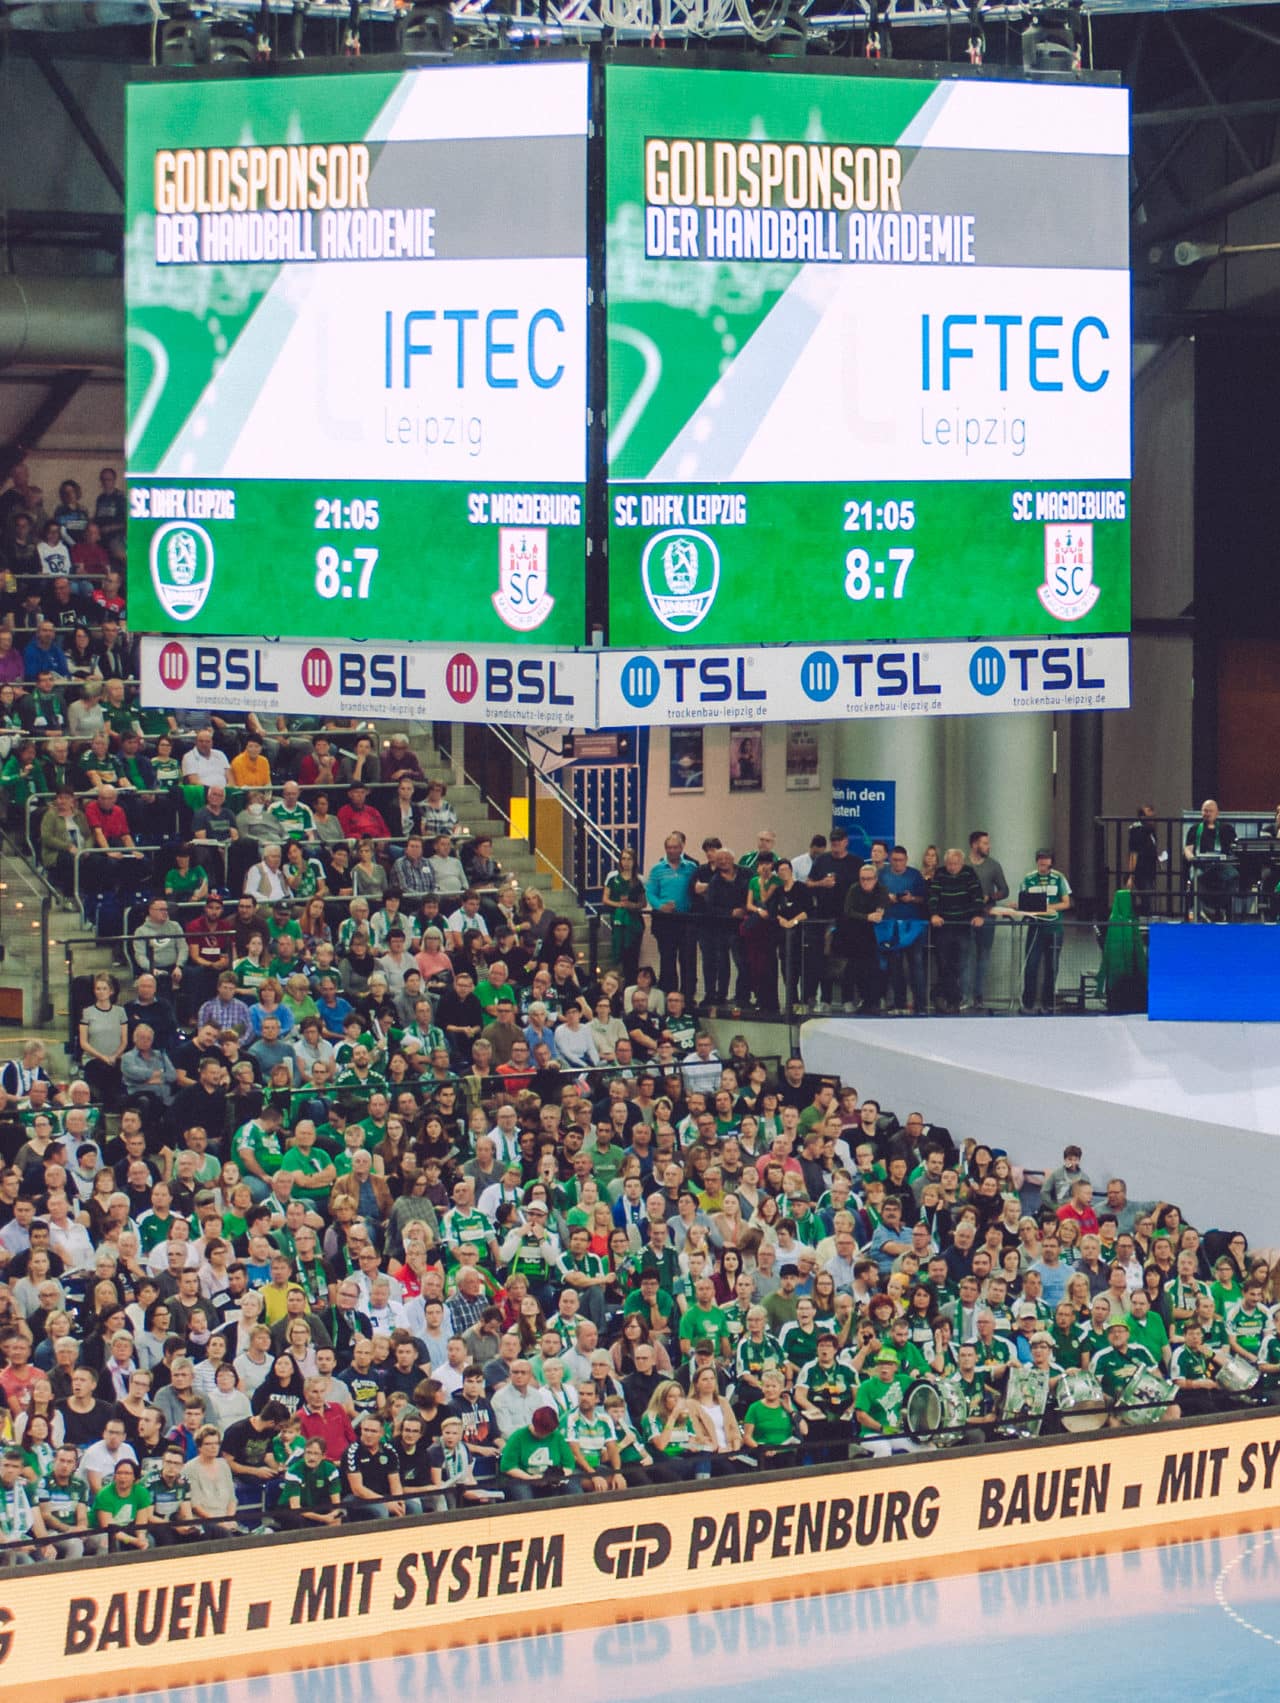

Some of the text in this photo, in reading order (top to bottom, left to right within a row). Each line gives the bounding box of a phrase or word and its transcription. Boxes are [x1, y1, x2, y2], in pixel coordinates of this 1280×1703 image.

[156, 143, 371, 213] GOLDSPONSOR
[645, 140, 902, 212] GOLDSPONSOR
[156, 208, 436, 264] DER HANDBALL AKADEMIE
[647, 206, 976, 264] DER HANDBALL AKADEMIE
[384, 309, 566, 390] IFTEC
[920, 314, 1111, 393] IFTEC
[130, 487, 150, 519] SC
[187, 488, 236, 520] LEIPZIG
[314, 498, 380, 530] 21:05
[467, 493, 581, 526] SC MAGDEBURG
[614, 494, 747, 526] SC DHFK LEIPZIG
[843, 501, 915, 531] 21:05
[1013, 491, 1126, 521] SC MAGDEBURG
[314, 546, 380, 599] 8:7
[844, 548, 915, 600] 8:7
[1055, 566, 1083, 596] SC
[196, 647, 278, 692] BSL
[340, 653, 426, 699] BSL
[486, 659, 574, 705] BSL
[664, 657, 767, 703] TSL
[842, 652, 942, 697] TSL
[1009, 648, 1105, 691] TSL
[859, 787, 886, 801] den
[978, 1463, 1110, 1529] BAUEN
[1156, 1446, 1231, 1504] MIT
[687, 1485, 940, 1569] PAPENBURG
[64, 1577, 233, 1656] BAUEN
[291, 1558, 382, 1624] MIT
[392, 1534, 565, 1610] SYSTEM
